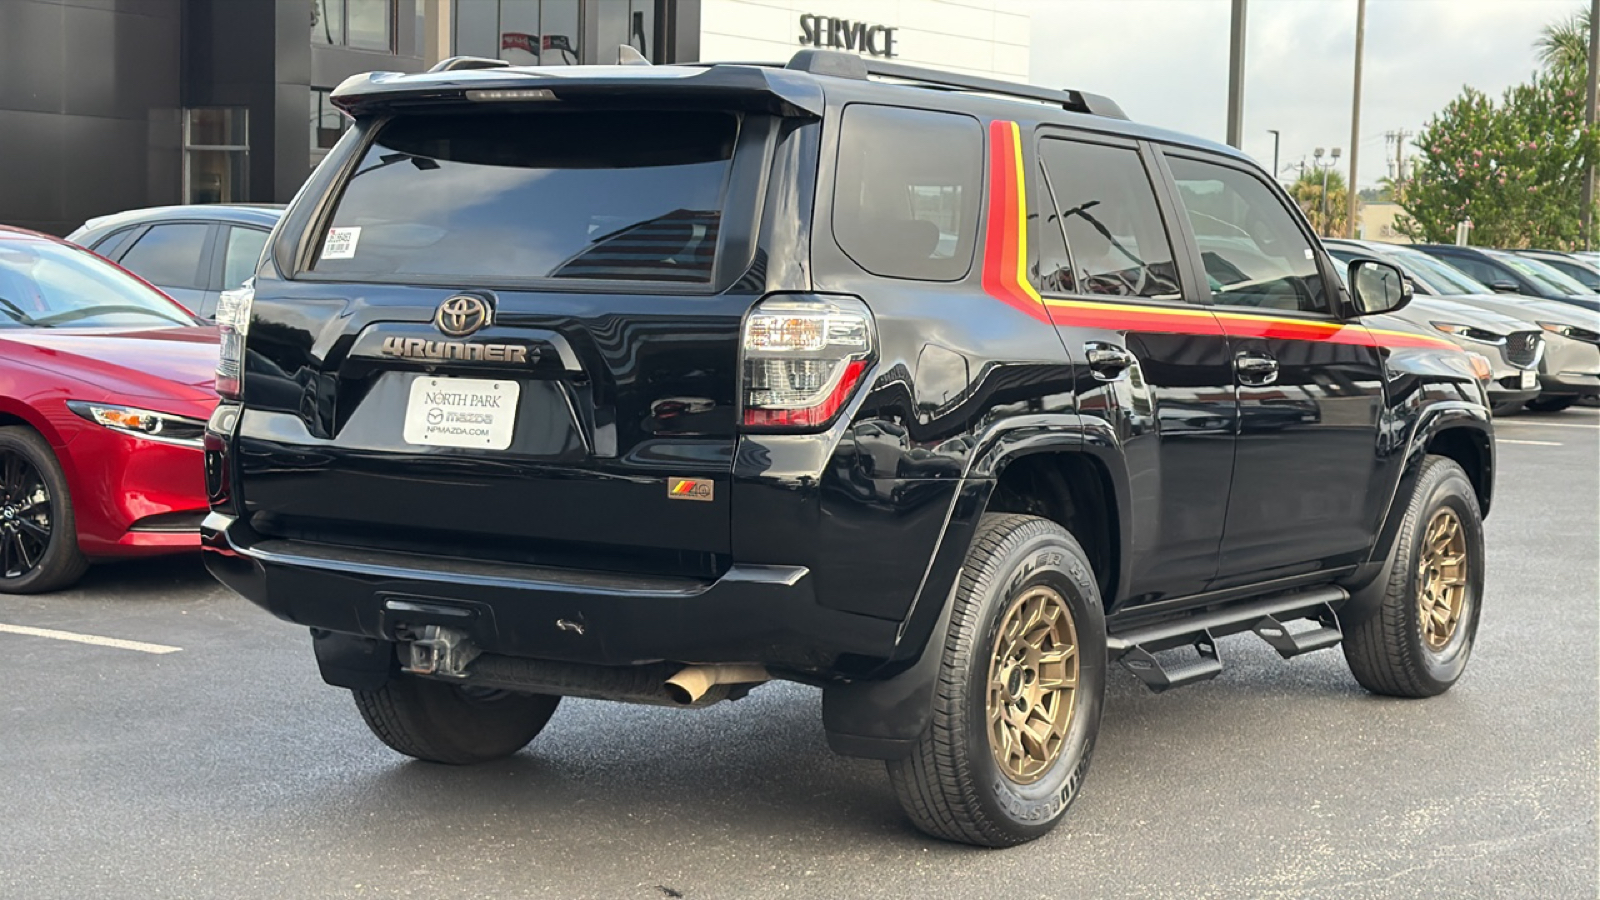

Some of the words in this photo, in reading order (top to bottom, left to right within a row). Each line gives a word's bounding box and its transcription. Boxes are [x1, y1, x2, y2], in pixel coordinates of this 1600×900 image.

[799, 13, 898, 58] SERVICE
[381, 336, 527, 363] 4RUNNER
[424, 390, 468, 406] NORTH
[470, 394, 501, 408] PARK
[426, 425, 490, 436] NPMAZDA.COM
